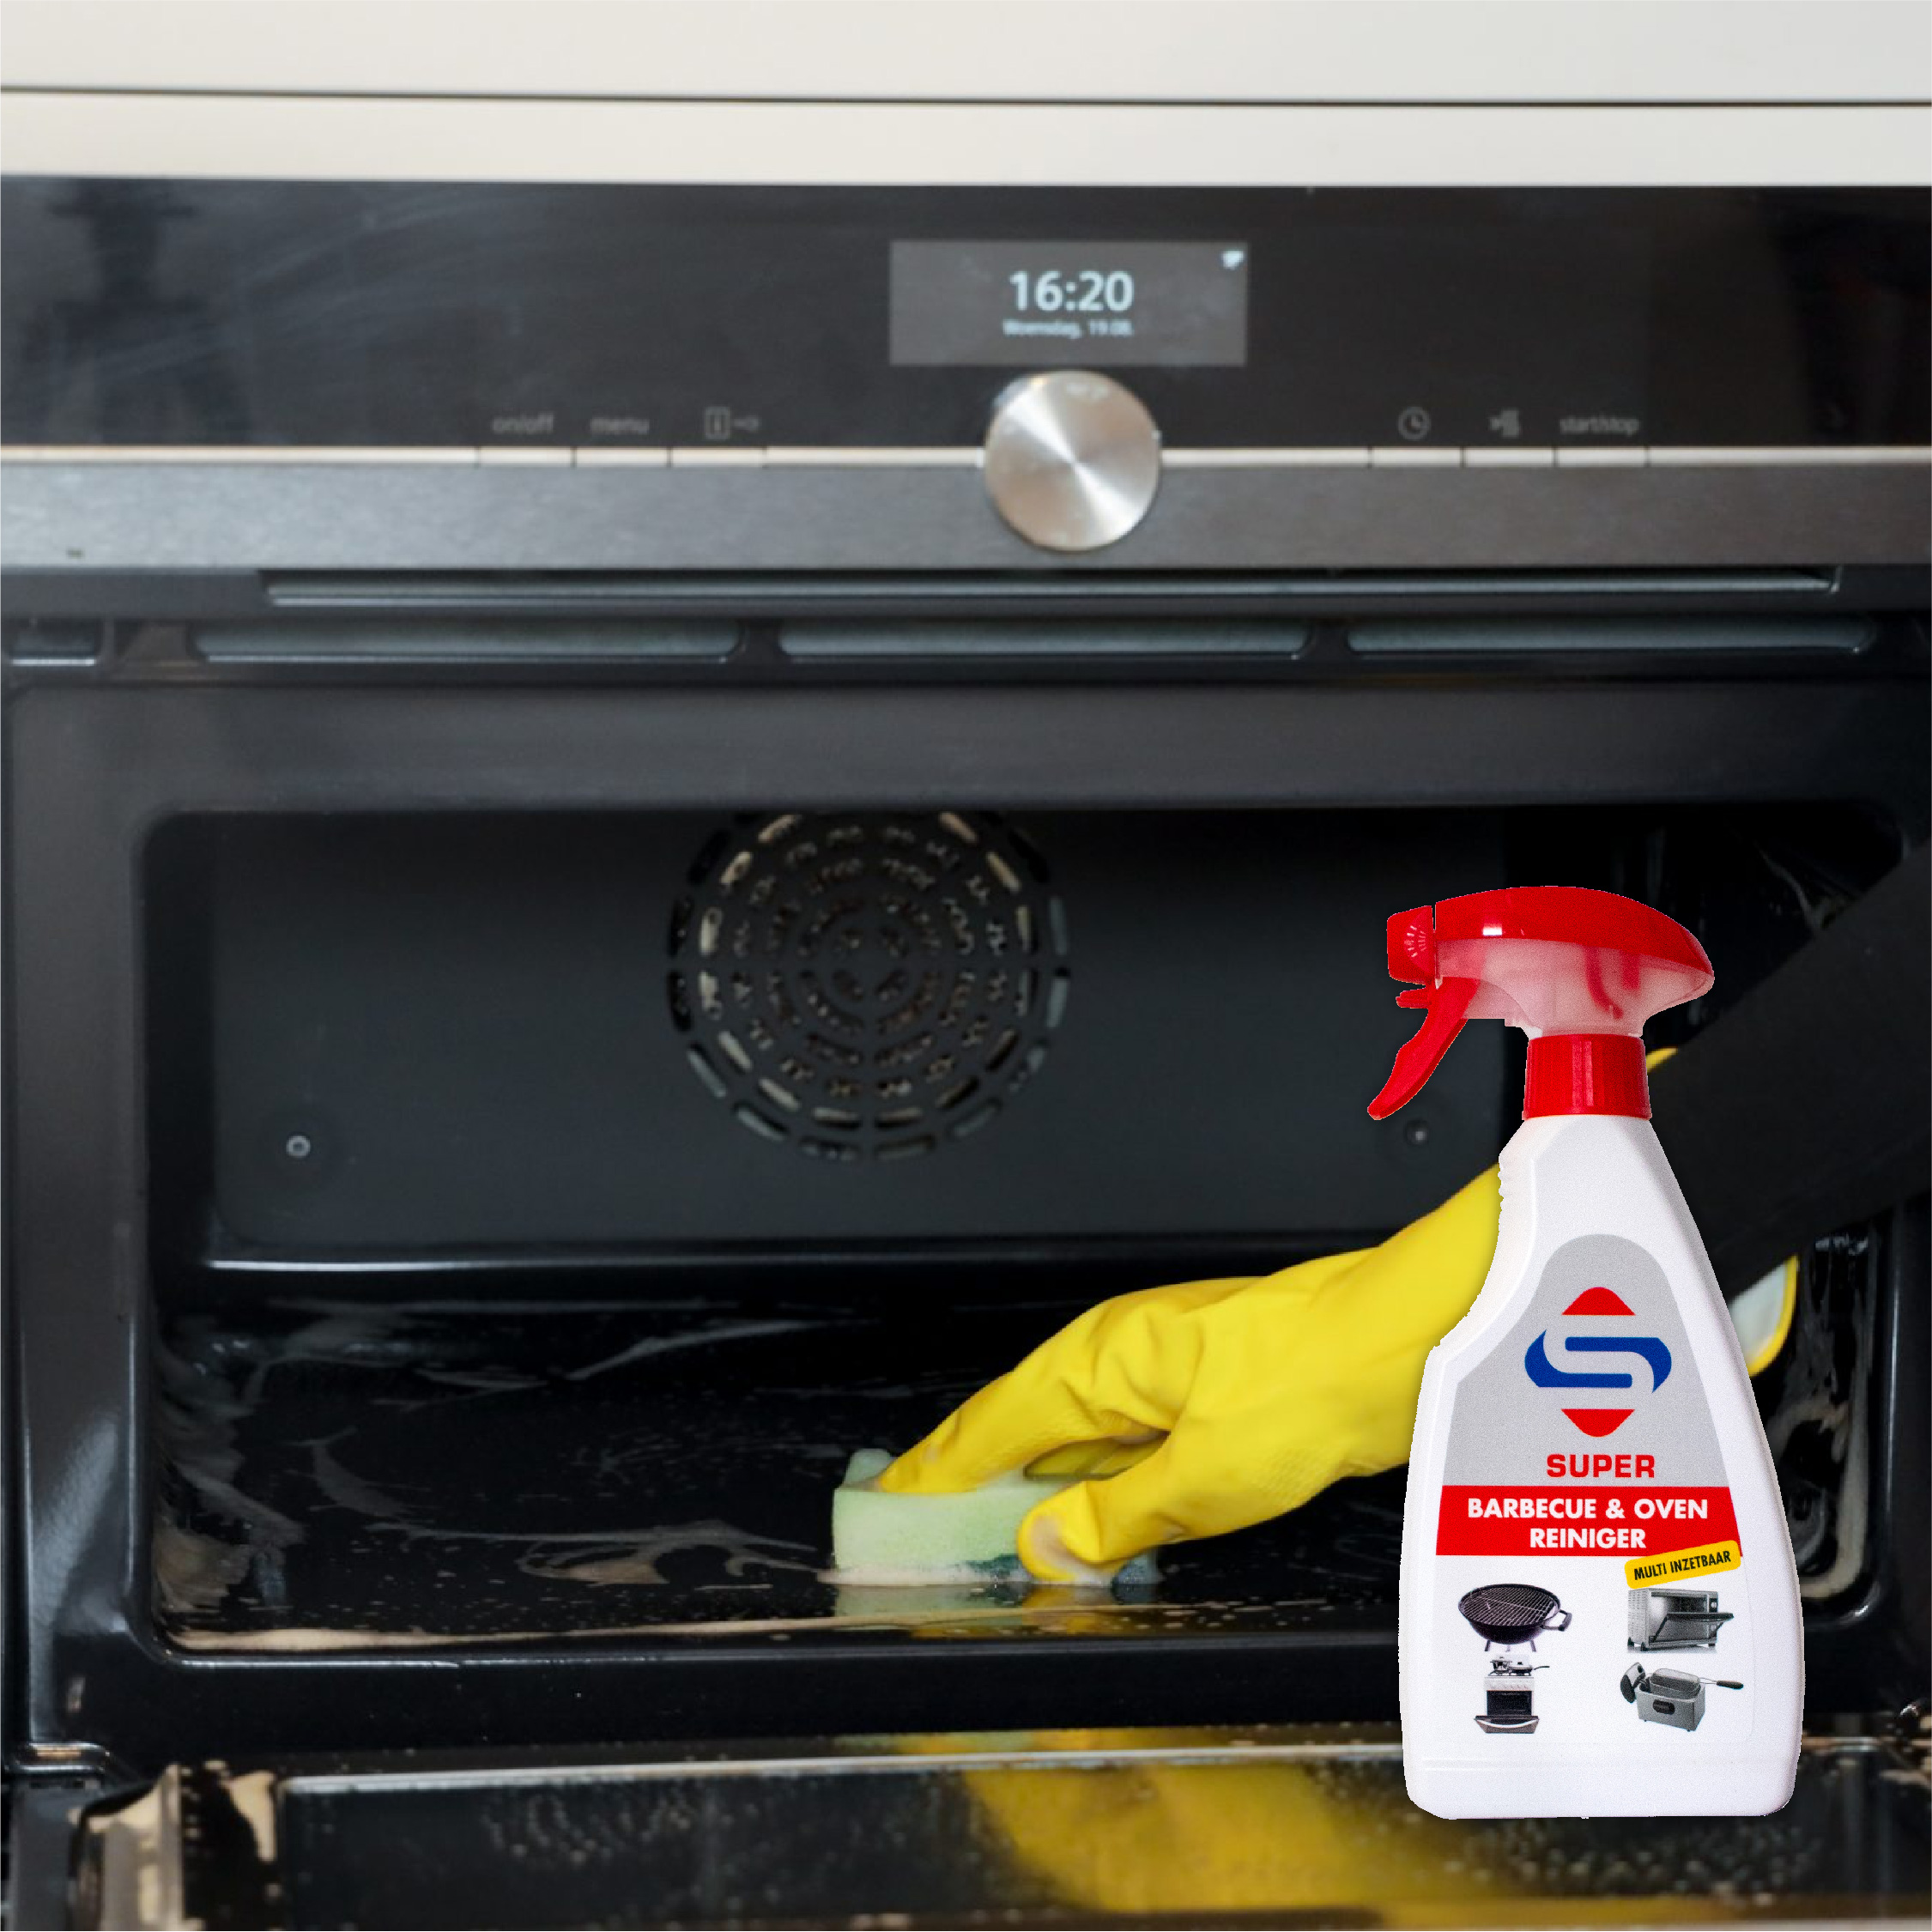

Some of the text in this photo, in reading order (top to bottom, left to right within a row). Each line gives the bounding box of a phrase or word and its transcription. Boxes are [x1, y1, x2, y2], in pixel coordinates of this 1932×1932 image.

[1008, 270, 1134, 312] 16:20
[1547, 1454, 1655, 1478] SUPER
[1468, 1498, 1708, 1519] BARBECUE & OVEN
[1530, 1528, 1647, 1548] REINIGER
[1633, 1550, 1732, 1581] MULTI INZETBAAR
